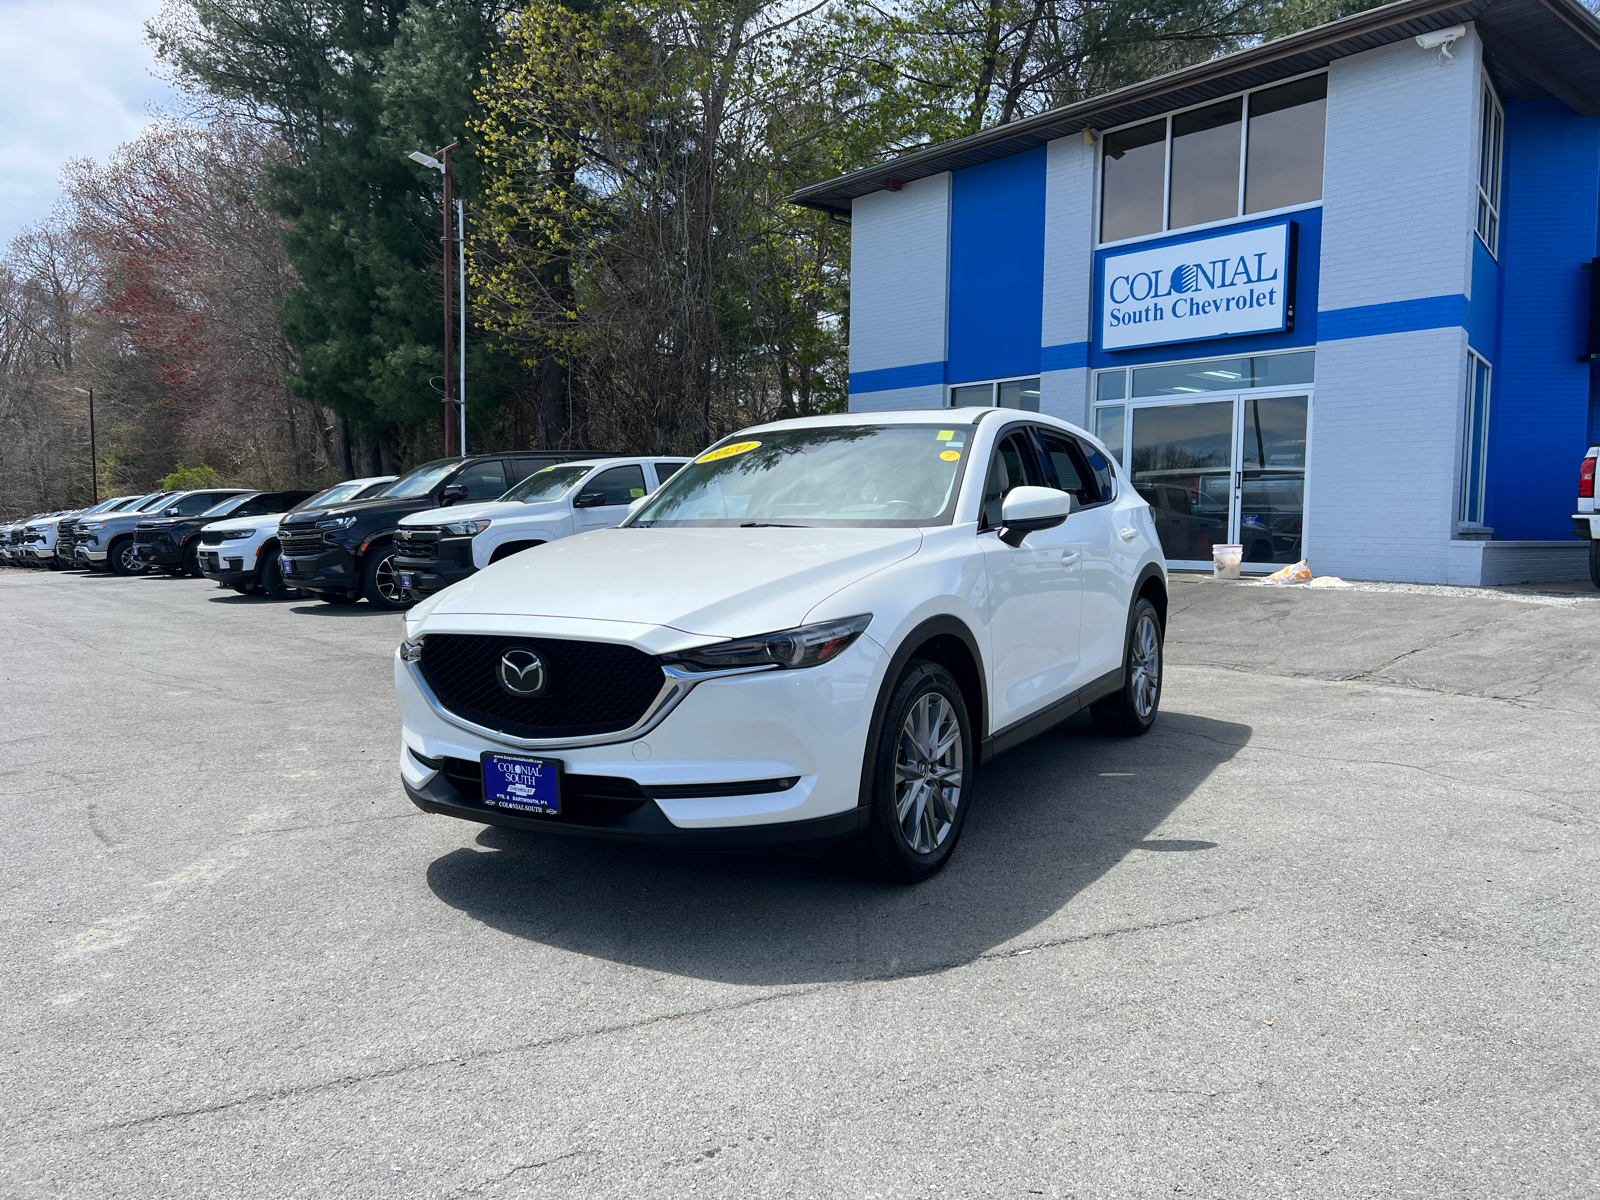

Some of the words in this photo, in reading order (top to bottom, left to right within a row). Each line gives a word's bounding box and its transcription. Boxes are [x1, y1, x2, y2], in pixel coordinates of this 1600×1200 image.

[1109, 252, 1278, 304] COLONIAL
[1109, 302, 1164, 327] South
[1171, 286, 1277, 319] Chevrolet
[497, 762, 542, 777] COLONIAL
[505, 773, 536, 786] SOUTH
[509, 785, 533, 794] CHEVROLET
[498, 801, 525, 811] COLONIAL
[524, 805, 543, 813] SOUTH
